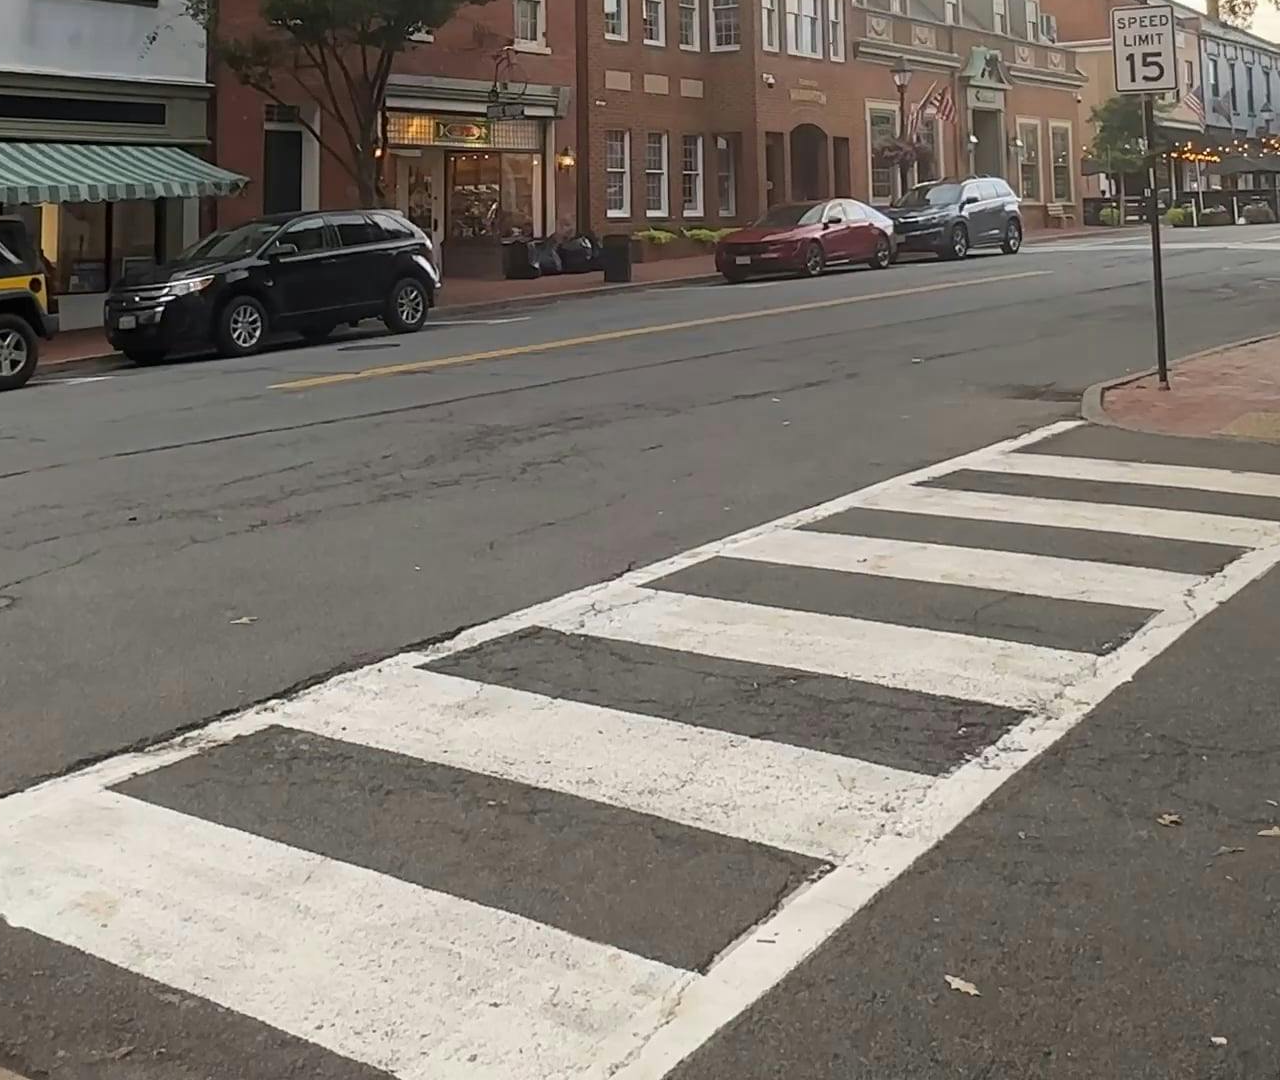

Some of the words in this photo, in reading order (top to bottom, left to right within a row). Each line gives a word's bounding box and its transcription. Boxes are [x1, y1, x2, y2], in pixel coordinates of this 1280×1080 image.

[1116, 14, 1168, 29] SPEED
[1123, 33, 1164, 48] LIMIT
[1125, 52, 1164, 82] 15
